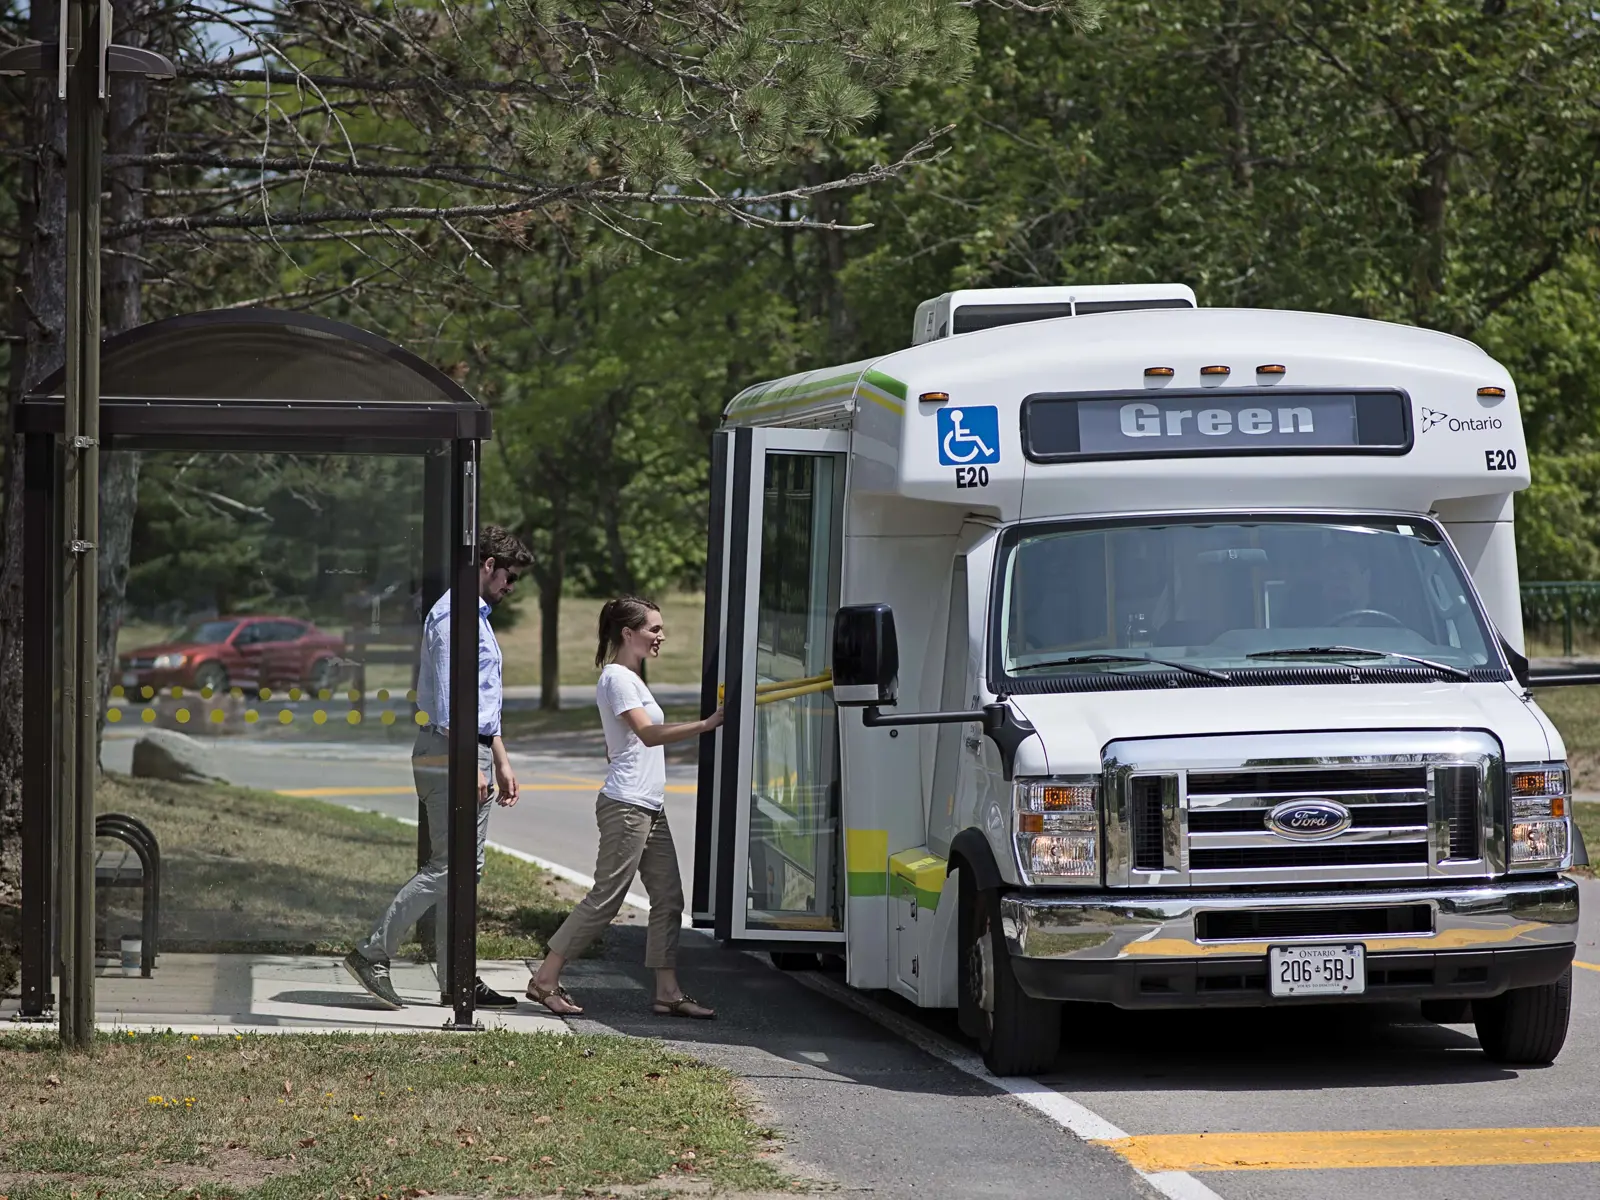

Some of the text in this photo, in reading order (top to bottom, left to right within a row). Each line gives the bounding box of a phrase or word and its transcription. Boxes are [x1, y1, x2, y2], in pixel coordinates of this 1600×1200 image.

[1119, 403, 1314, 438] Green
[1448, 416, 1502, 432] Ontario
[1485, 449, 1517, 471] E20
[955, 466, 989, 489] E20
[1291, 810, 1328, 827] Ford
[1299, 950, 1336, 958] ONTARIO
[1281, 958, 1355, 983] 206 5BJ
